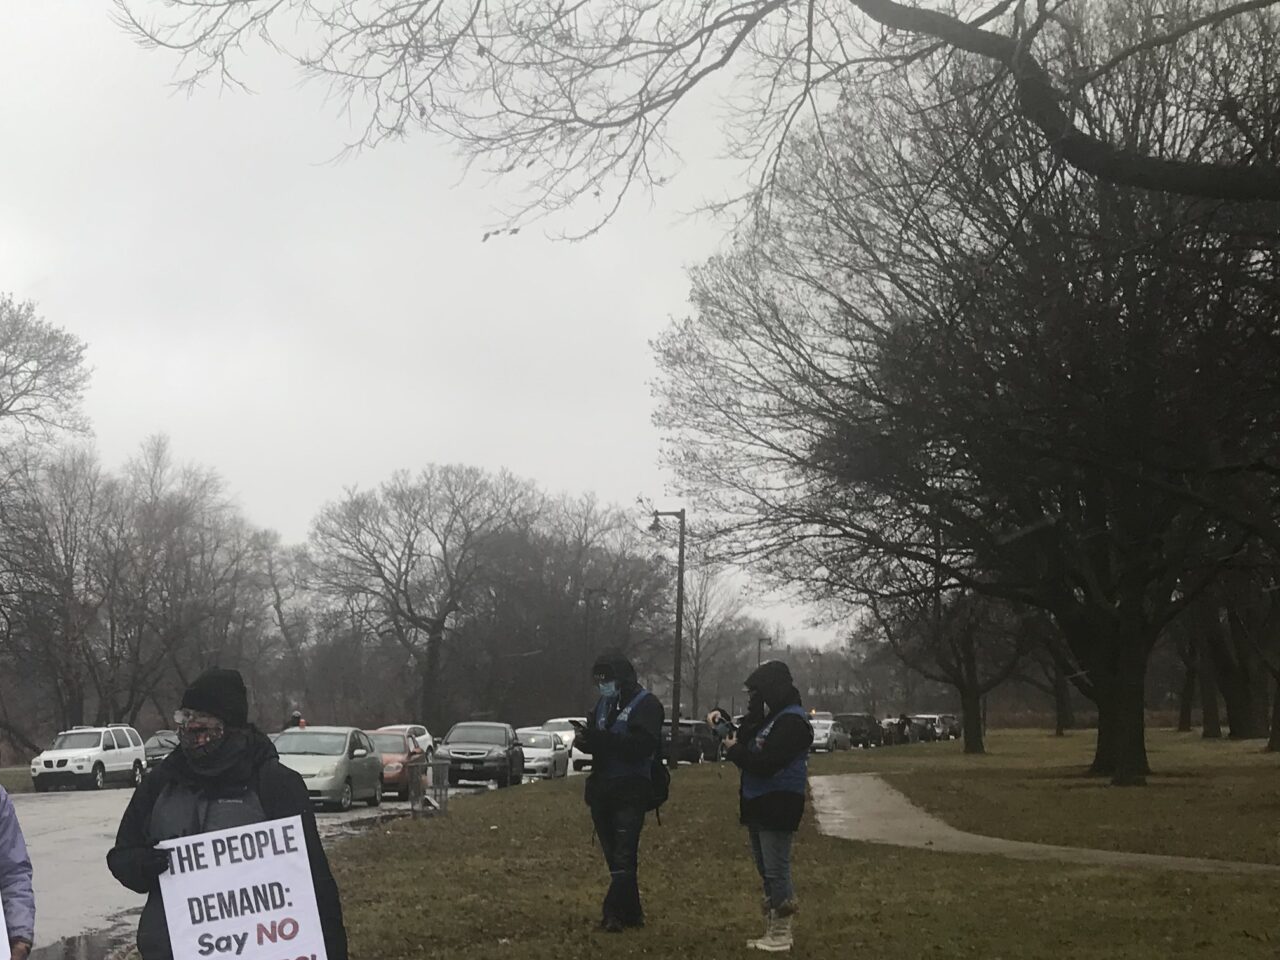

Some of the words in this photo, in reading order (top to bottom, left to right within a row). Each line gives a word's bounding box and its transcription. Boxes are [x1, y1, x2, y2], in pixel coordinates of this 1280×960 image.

[167, 842, 209, 876] THE
[211, 825, 299, 867] PEOPLE
[187, 882, 293, 925] DEMAND:
[198, 932, 249, 956] Say
[256, 918, 300, 946] NO
